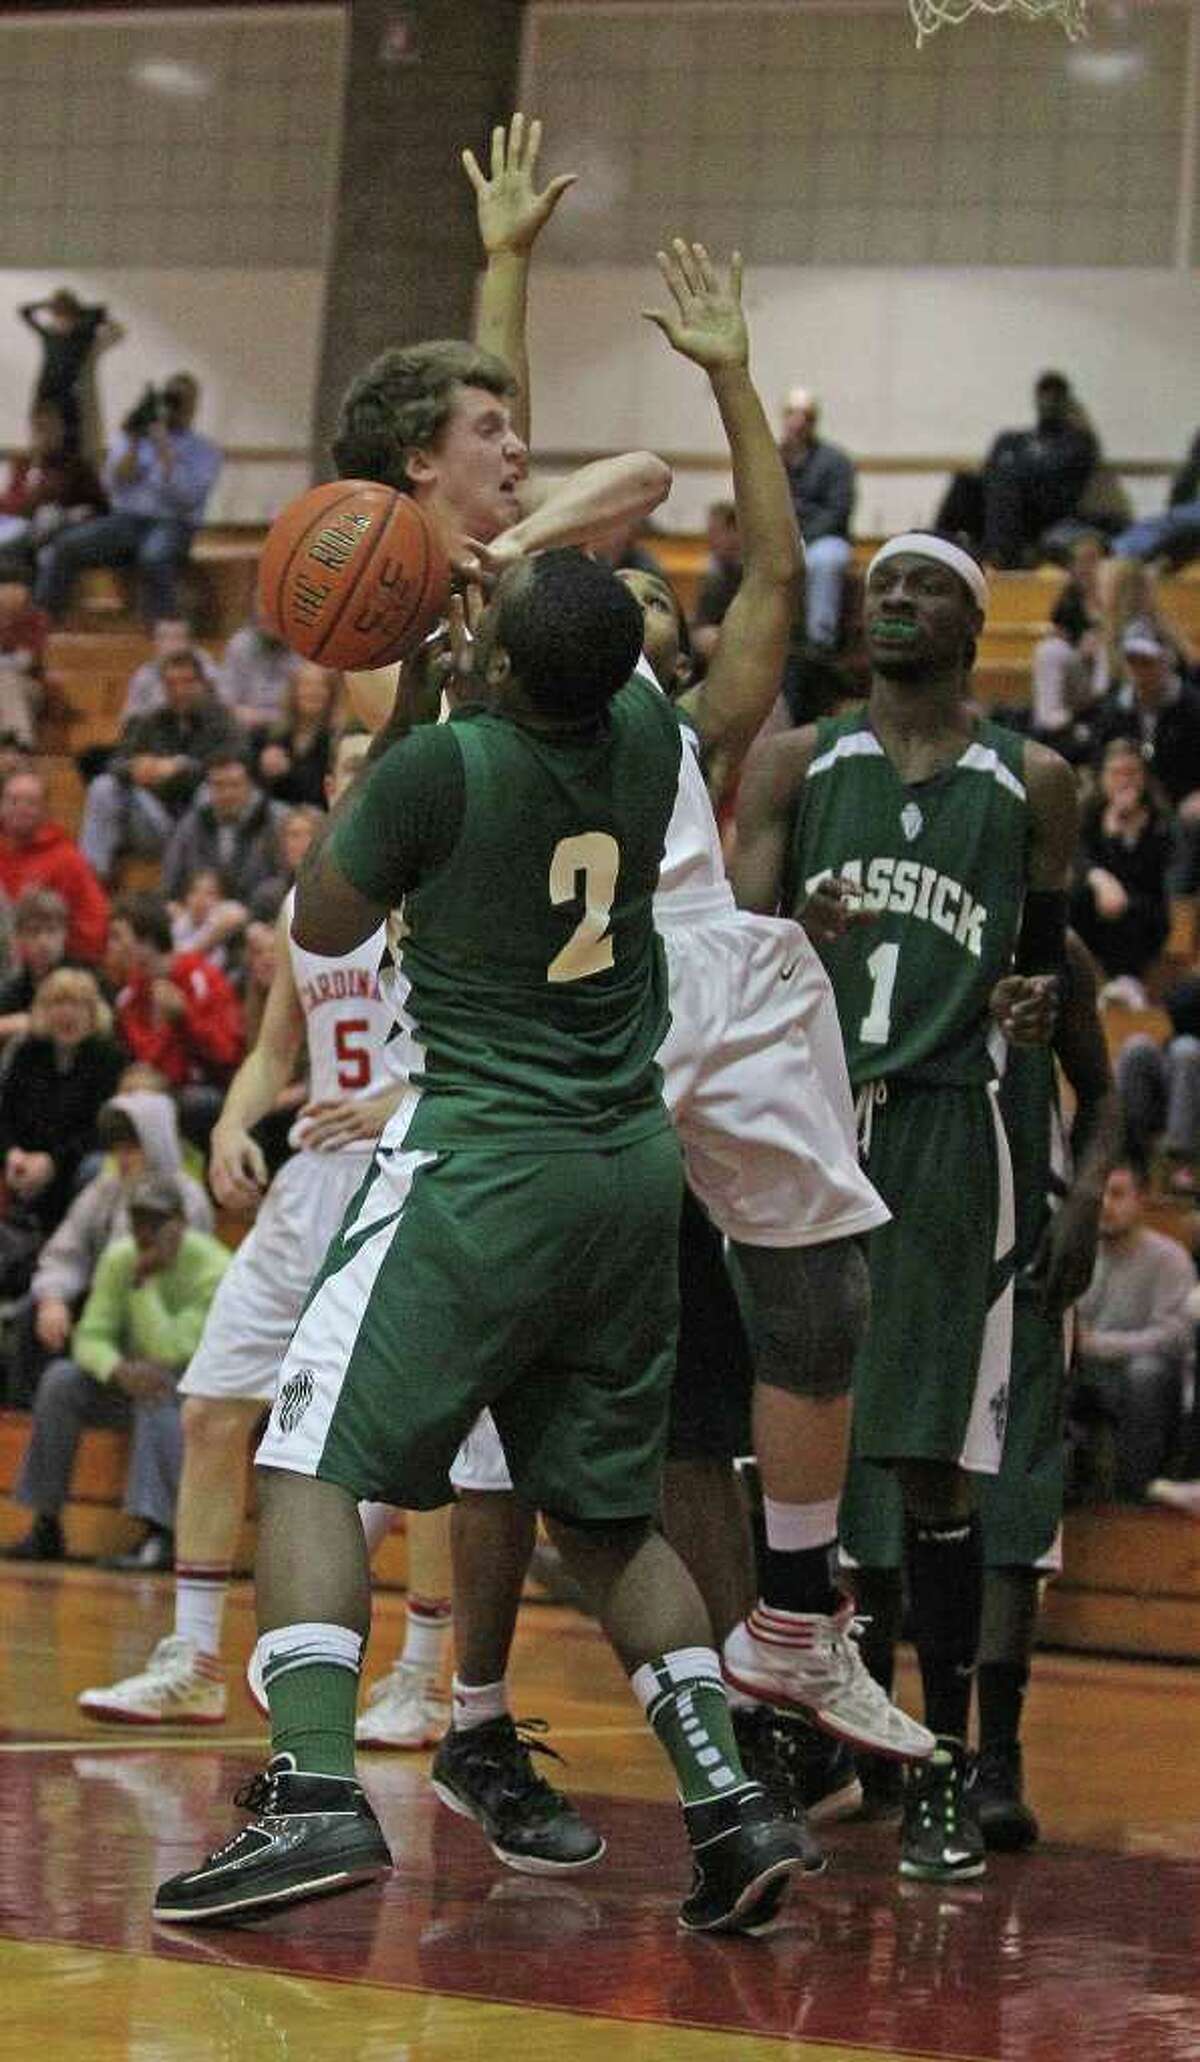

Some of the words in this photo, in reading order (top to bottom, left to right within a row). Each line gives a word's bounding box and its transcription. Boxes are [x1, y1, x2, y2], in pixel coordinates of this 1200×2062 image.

[547, 831, 619, 982] 2
[860, 942, 900, 1044] 1
[334, 1019, 371, 1091] 5
